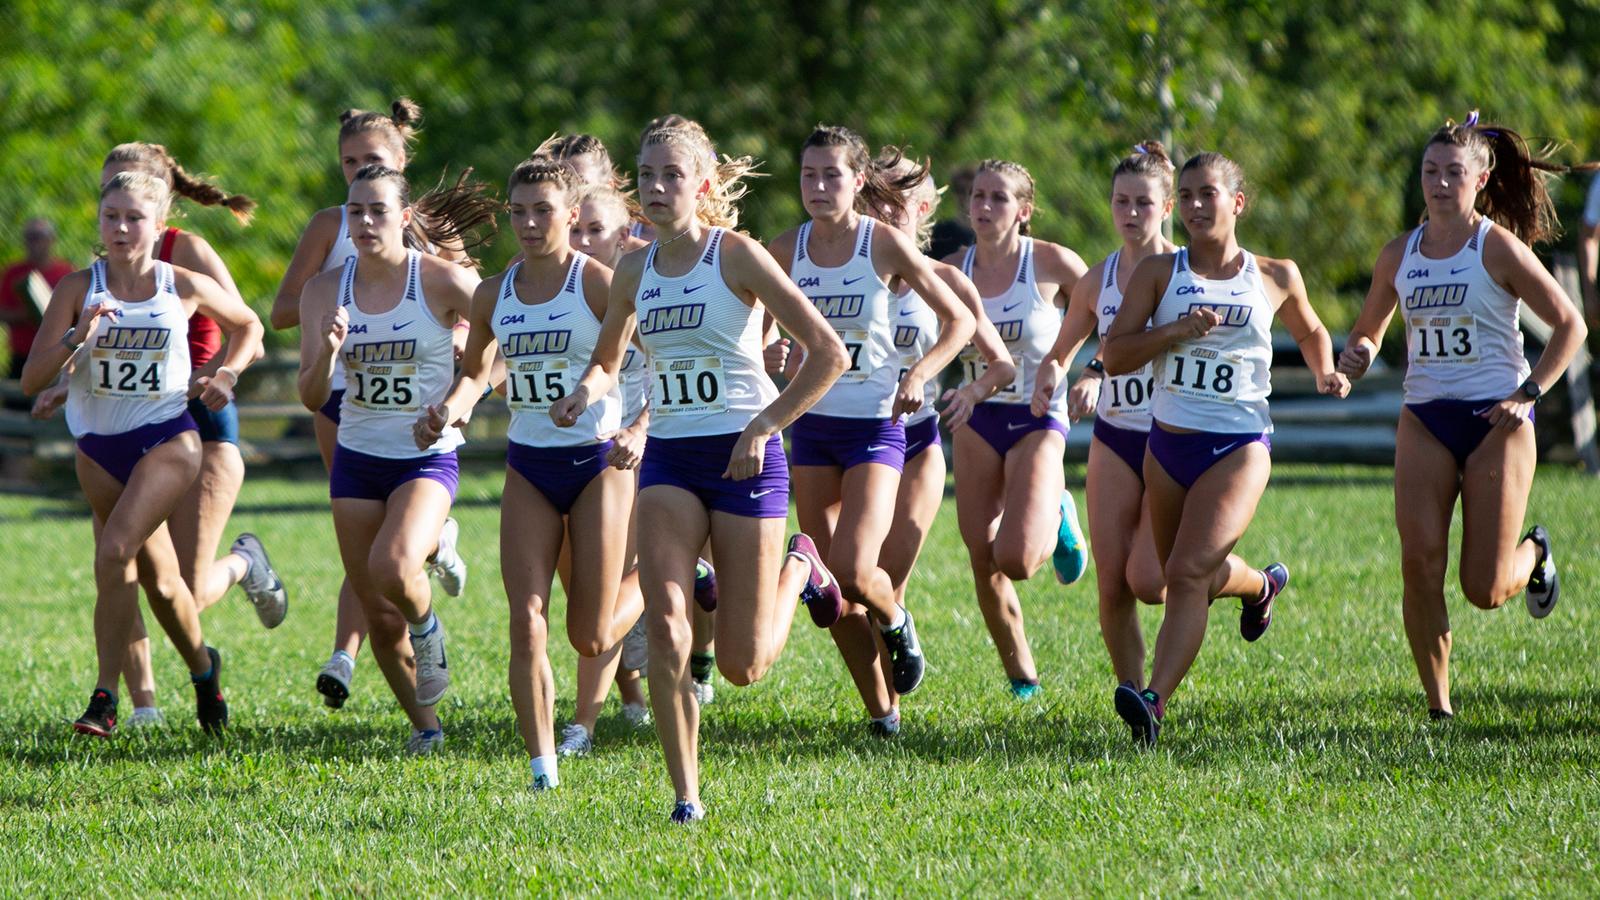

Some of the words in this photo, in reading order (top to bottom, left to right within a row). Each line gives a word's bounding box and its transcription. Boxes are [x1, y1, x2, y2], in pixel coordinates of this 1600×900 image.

[798, 277, 820, 287] CAA
[1407, 269, 1429, 279] CAA
[642, 288, 661, 300] CAA
[1176, 286, 1205, 295] CAA
[1406, 284, 1469, 310] JMU
[808, 295, 865, 318] MU
[1103, 306, 1117, 315] CA
[500, 314, 525, 325] CAA
[640, 303, 706, 335] JMU
[96, 326, 171, 349] JMU
[502, 329, 572, 358] JMU
[1419, 327, 1472, 357] 113
[115, 351, 143, 360] JMU
[346, 339, 417, 362] JMU
[1191, 347, 1219, 360] JMU
[99, 360, 161, 391] 124
[367, 365, 392, 375] JMU
[518, 361, 544, 372] JMU
[670, 360, 695, 371] JMU
[1171, 356, 1234, 393] 118
[355, 372, 412, 405] 125
[510, 372, 566, 403] 115
[659, 371, 719, 405] 110
